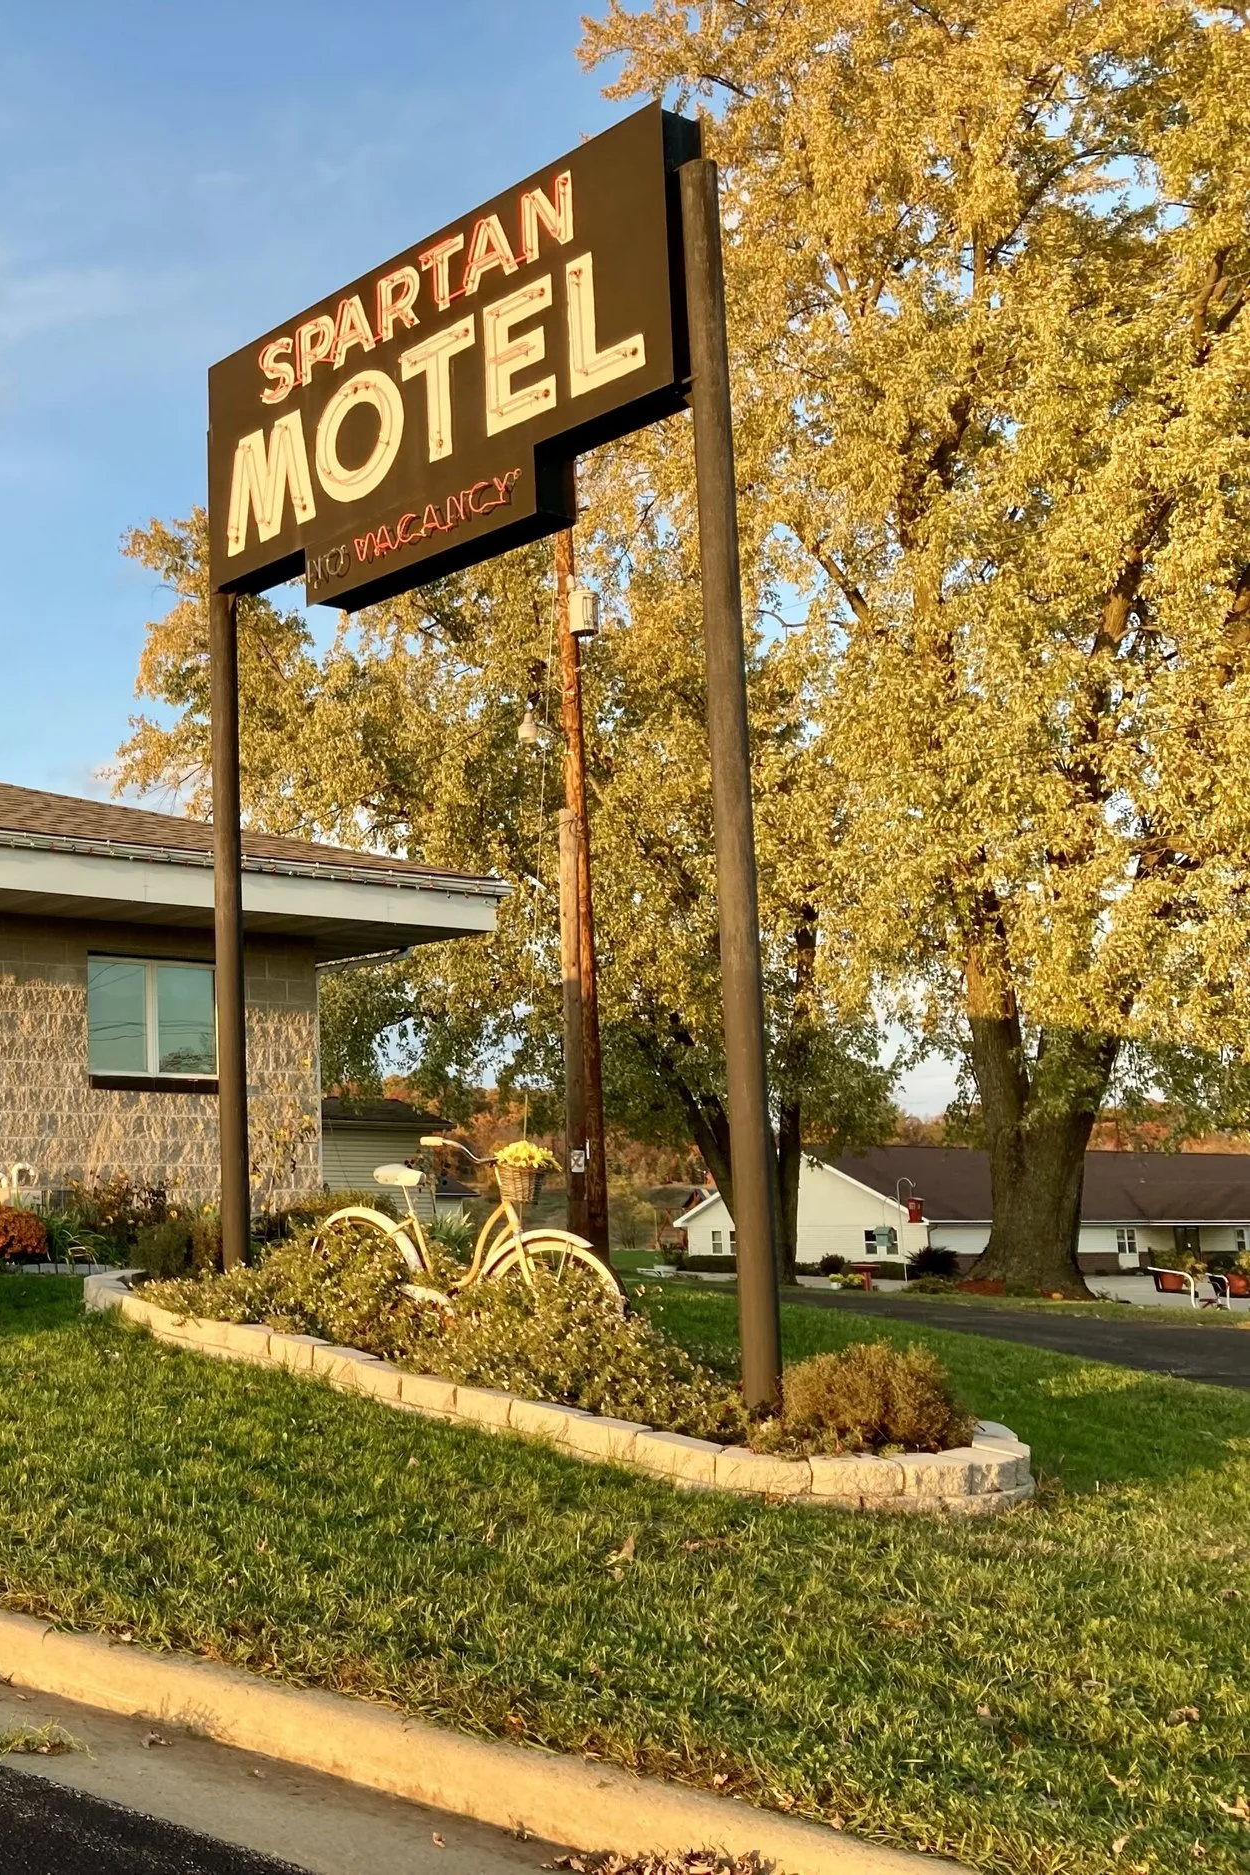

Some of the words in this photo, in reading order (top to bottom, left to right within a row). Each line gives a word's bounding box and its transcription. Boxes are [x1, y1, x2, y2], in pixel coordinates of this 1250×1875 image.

[259, 170, 573, 404] SPARTAN
[227, 252, 646, 557] MOTEL
[307, 544, 349, 589] NO
[354, 469, 522, 562] VACANCY
